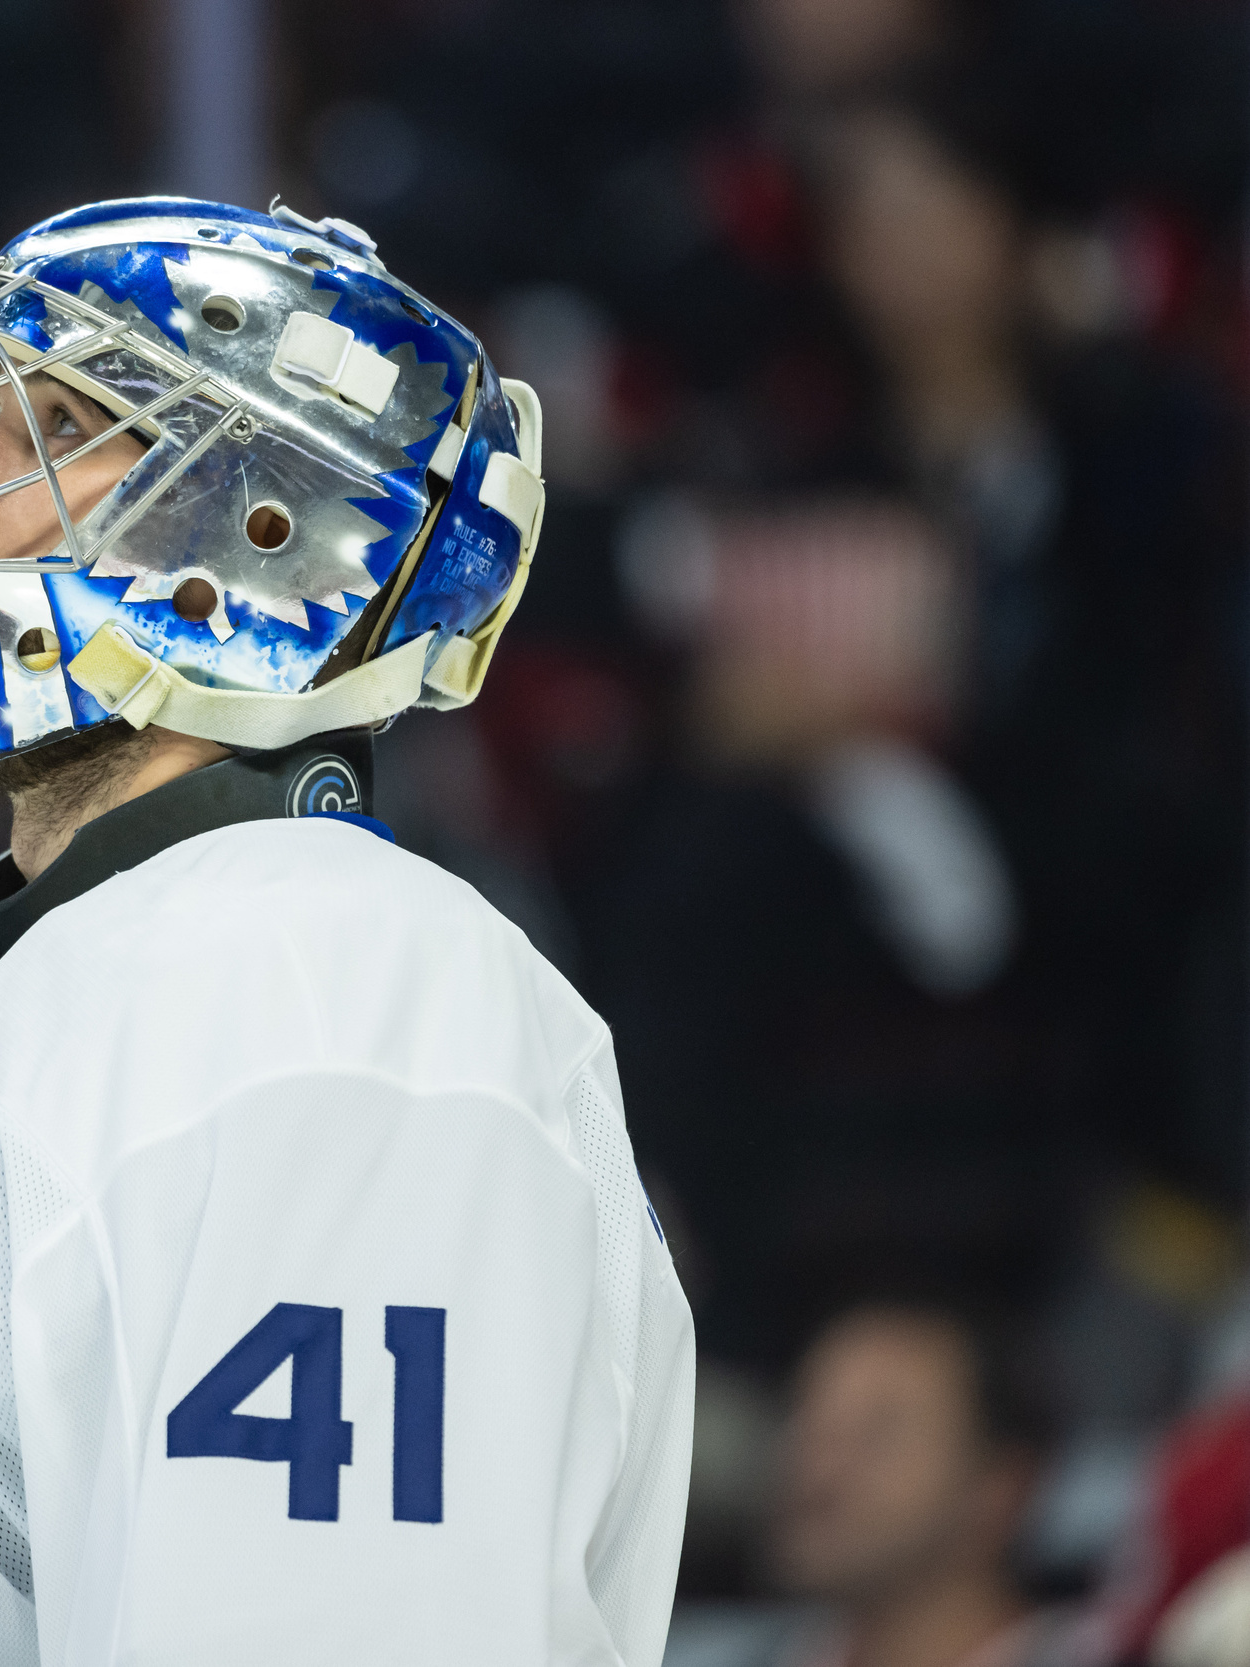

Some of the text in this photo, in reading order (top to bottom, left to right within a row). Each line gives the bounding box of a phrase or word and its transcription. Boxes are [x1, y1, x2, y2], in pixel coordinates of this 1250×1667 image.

[453, 524, 477, 544] RULE
[442, 537, 492, 576] NO EXCUSES
[442, 558, 481, 590] PLAY LIKE
[167, 1302, 446, 1524] 41
